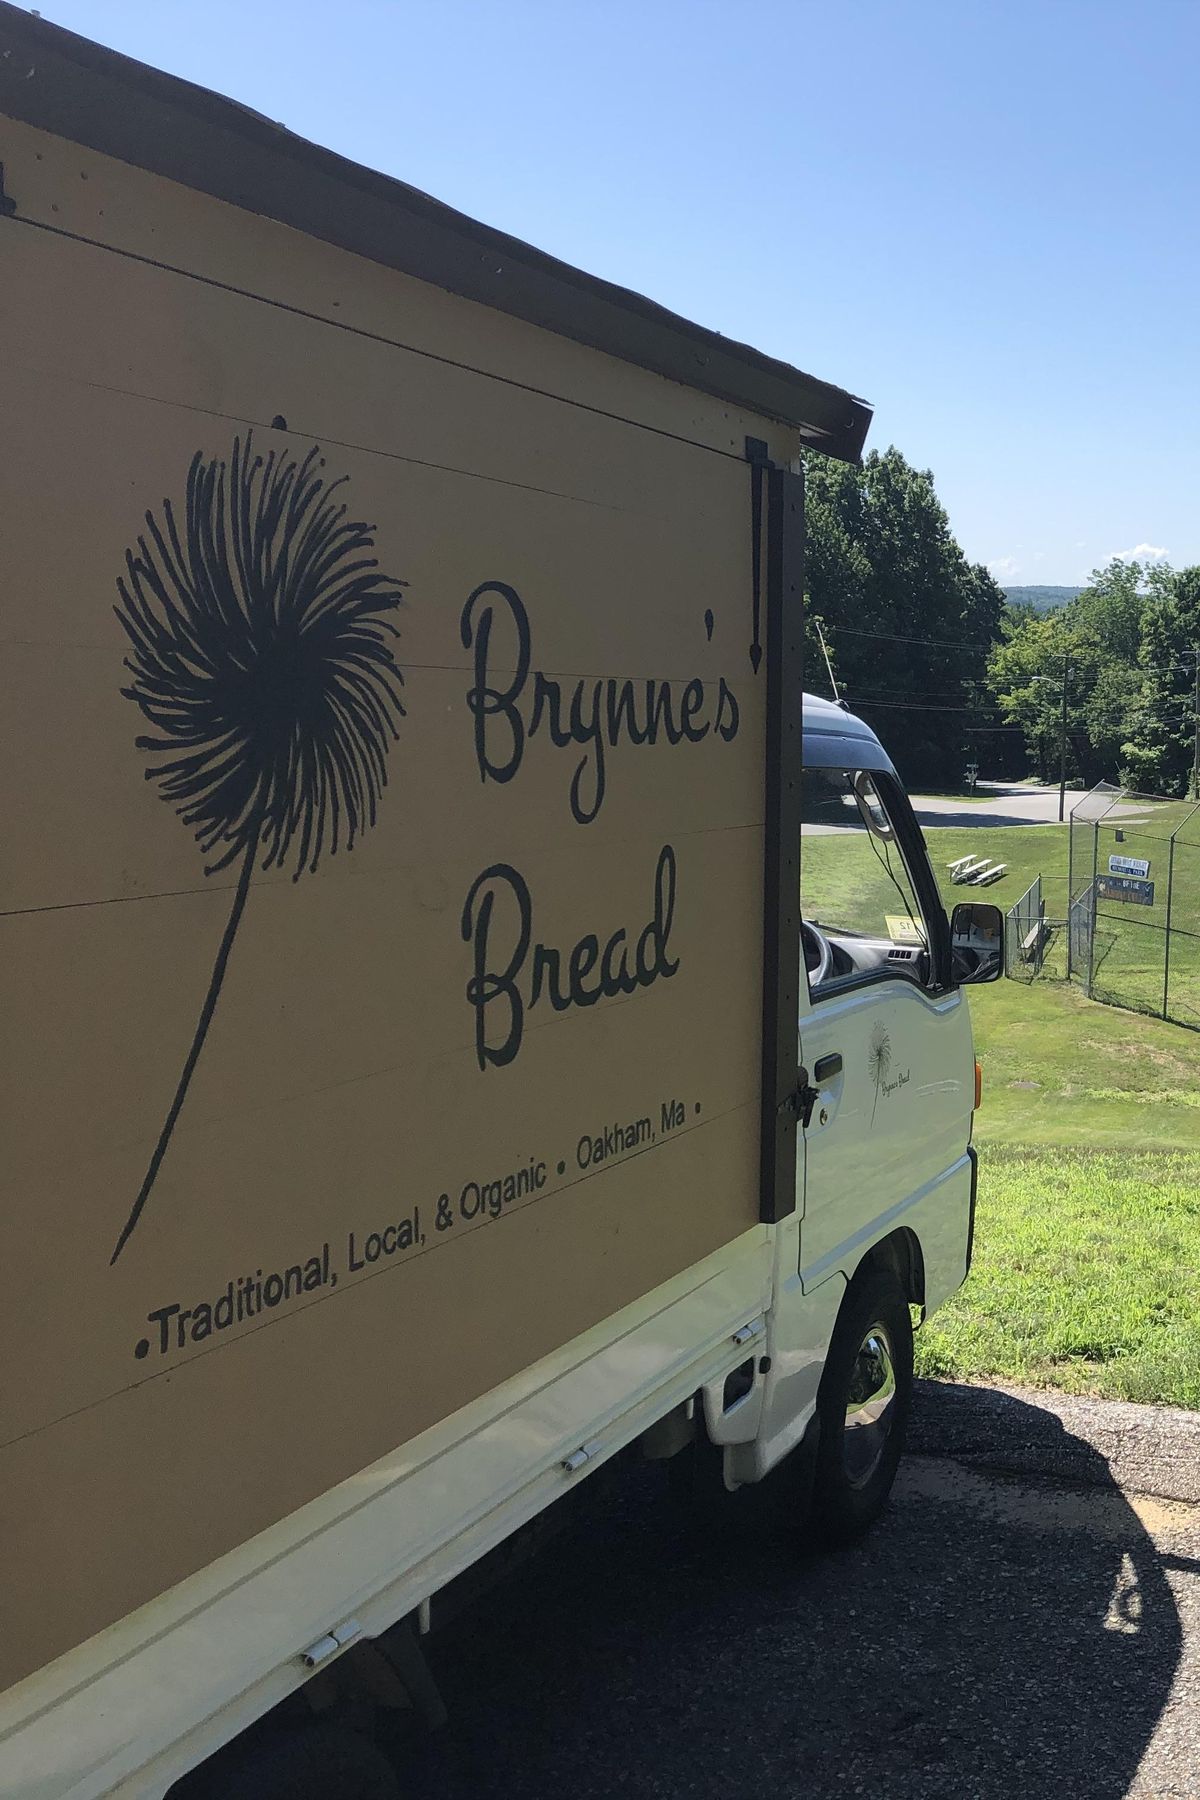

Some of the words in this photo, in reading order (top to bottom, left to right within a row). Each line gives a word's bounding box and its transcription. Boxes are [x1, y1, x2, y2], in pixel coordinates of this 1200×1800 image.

[460, 580, 740, 825] Brynne's
[461, 844, 681, 1071] Bread
[147, 1242, 338, 1354] Traditional,
[349, 1206, 426, 1272] Local,
[435, 1193, 454, 1232] &
[460, 1156, 547, 1220] Organic
[576, 1117, 656, 1170] Oakham,
[661, 1099, 686, 1134] Ma
